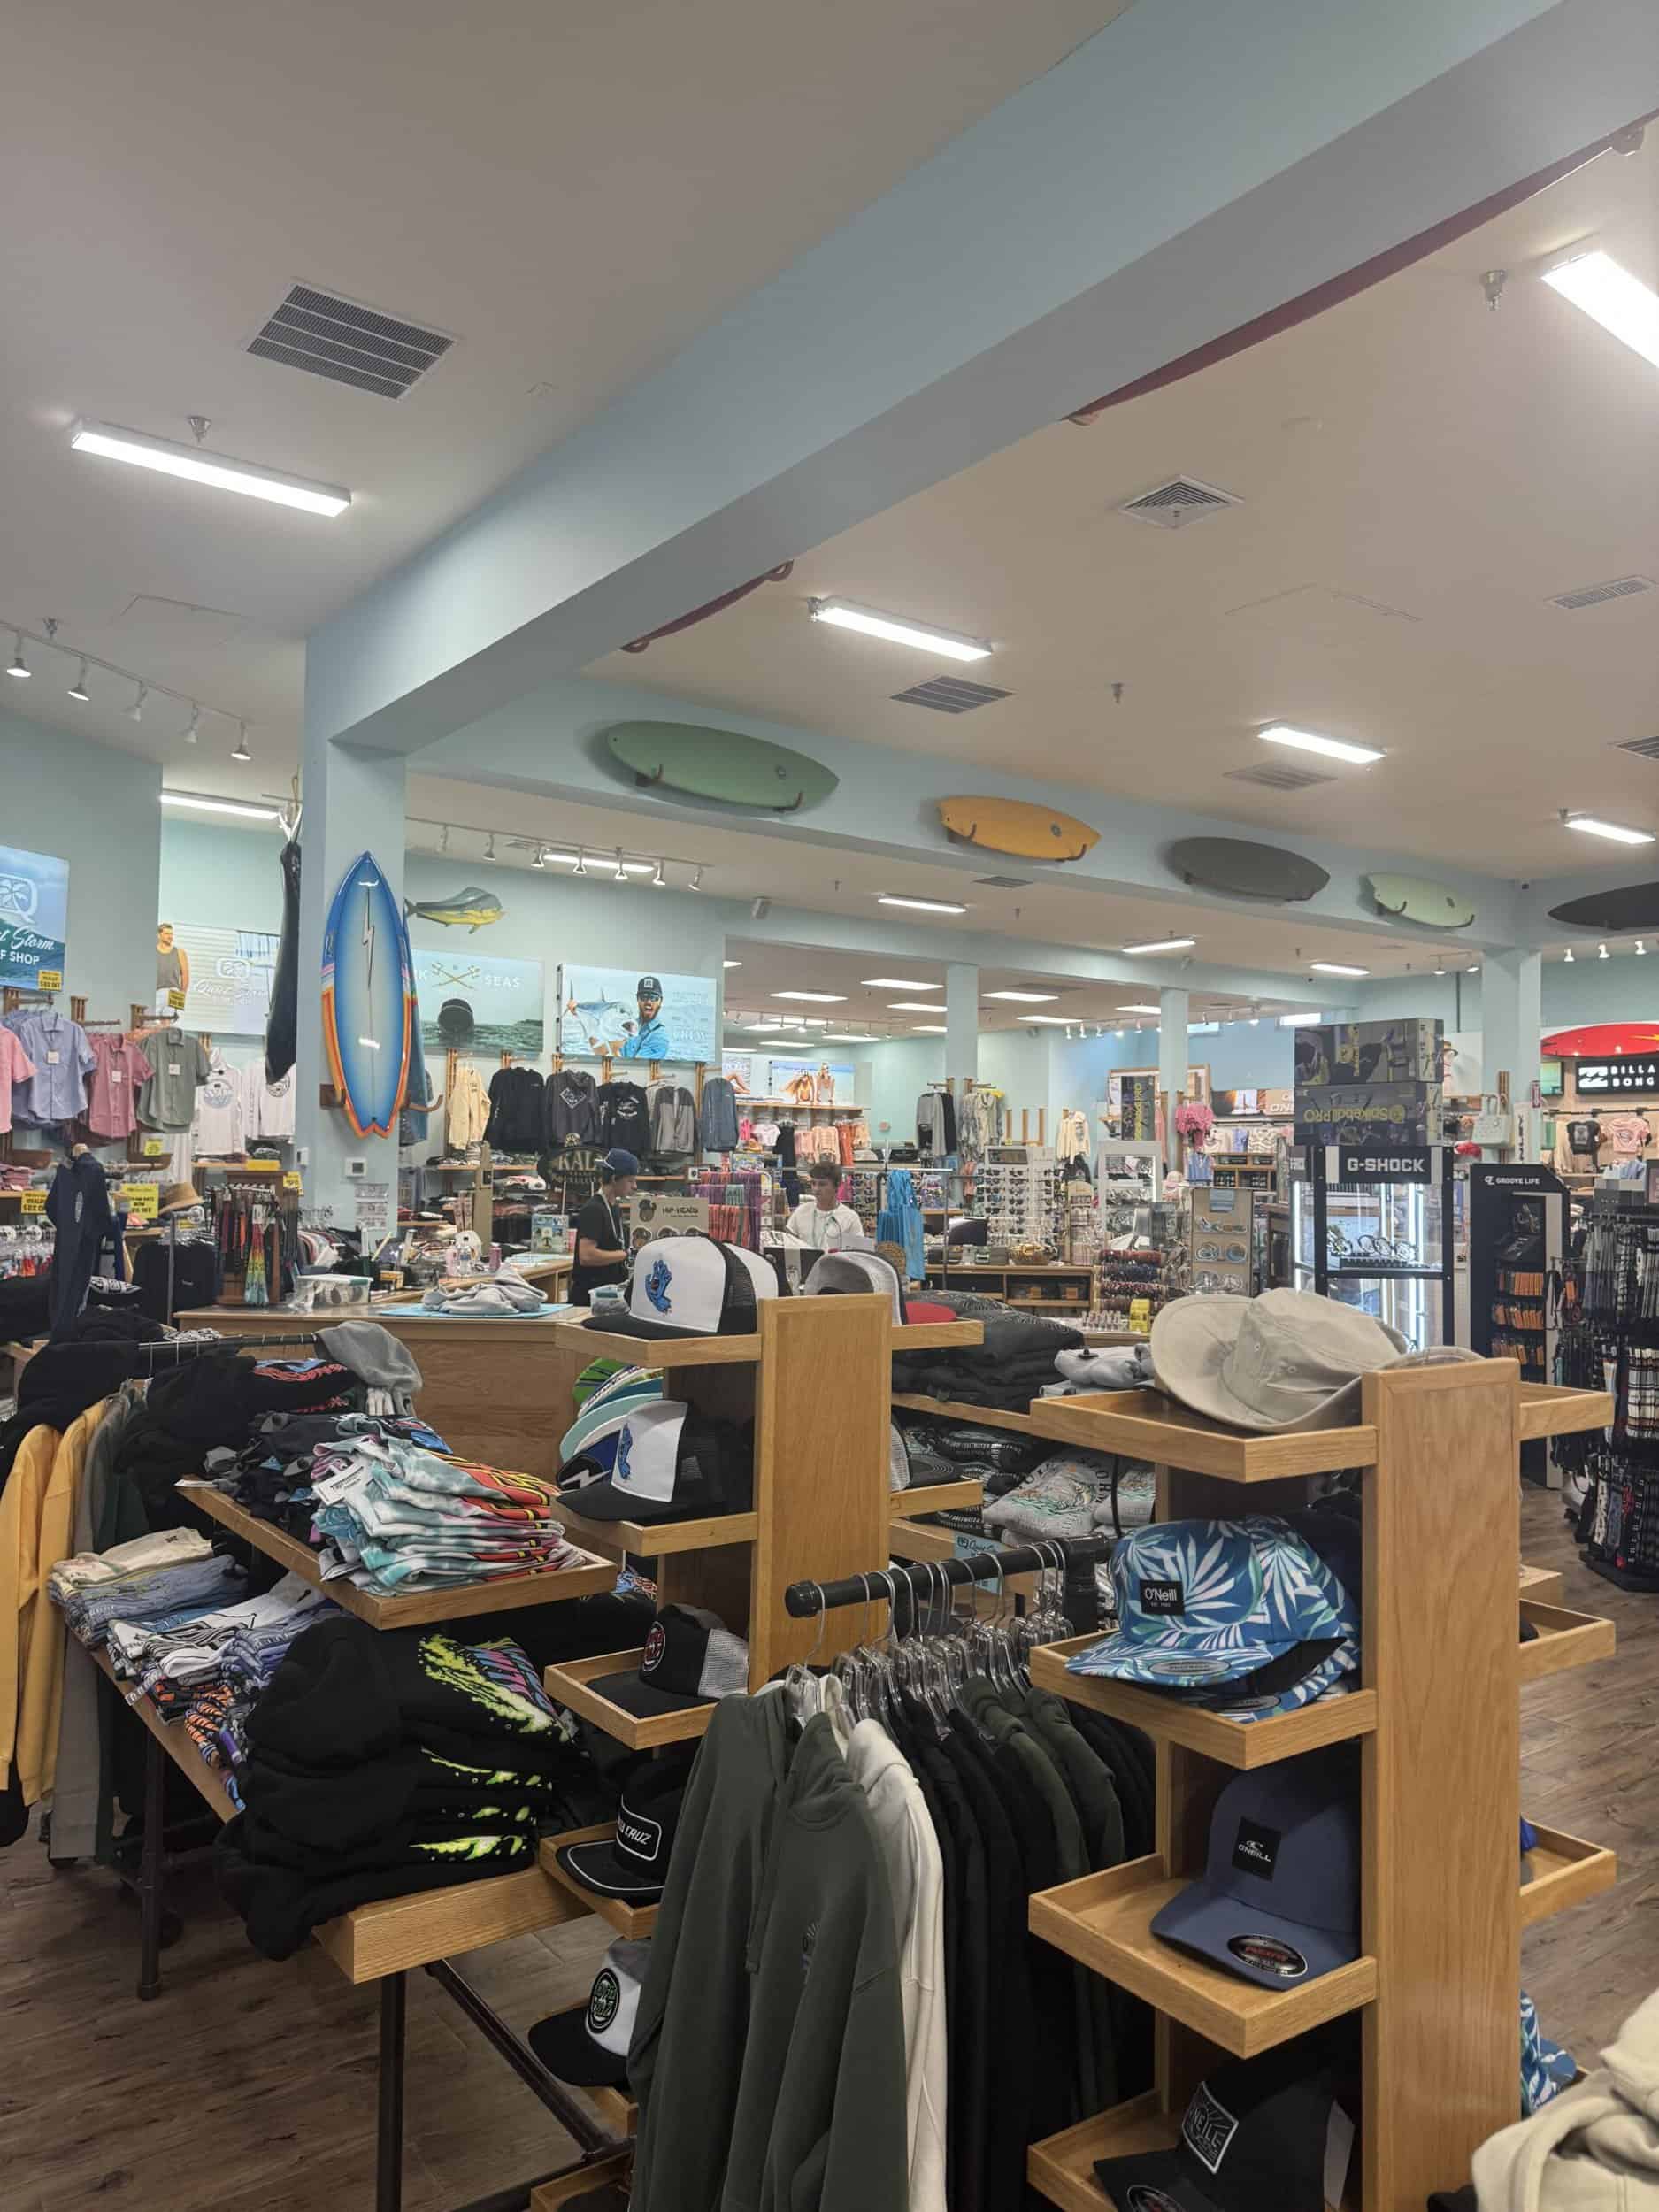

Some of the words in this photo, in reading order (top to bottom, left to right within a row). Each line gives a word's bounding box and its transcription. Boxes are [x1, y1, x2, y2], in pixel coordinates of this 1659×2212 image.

[11, 925, 54, 950] Storm
[10, 951, 40, 965] SHOP
[484, 975, 521, 988] SEAS
[1347, 1157, 1425, 1172] G-SHOCK
[1145, 1587, 1177, 1601] O'Neill
[625, 1825, 652, 1845] CRUZ
